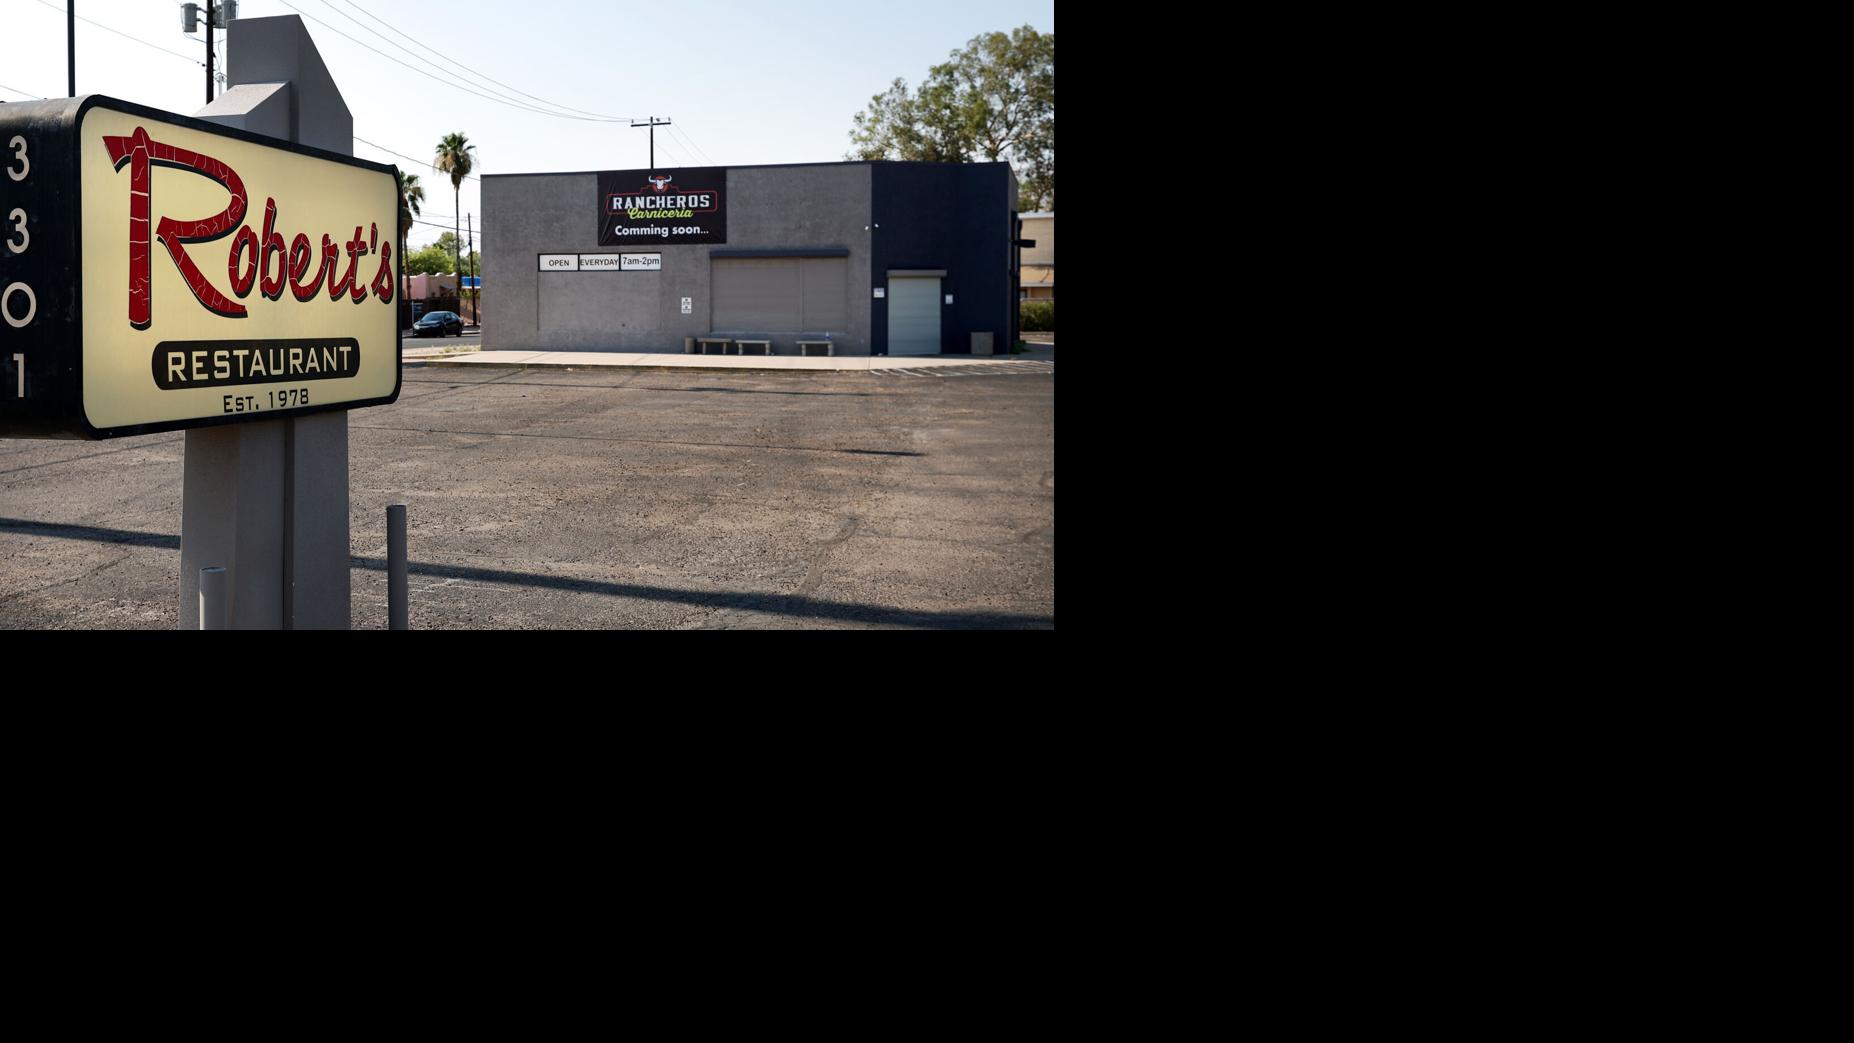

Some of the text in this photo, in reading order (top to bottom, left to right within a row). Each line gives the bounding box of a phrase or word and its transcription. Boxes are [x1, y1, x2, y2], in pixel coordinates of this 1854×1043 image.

[612, 194, 710, 210] RANCHEROS
[102, 126, 394, 331] Robert's
[614, 224, 709, 237] Comming soon...
[548, 256, 660, 267] OPEN EVERYDAY 7am-2pm
[167, 346, 352, 382] RESTAURANT
[268, 388, 309, 408] 1978
